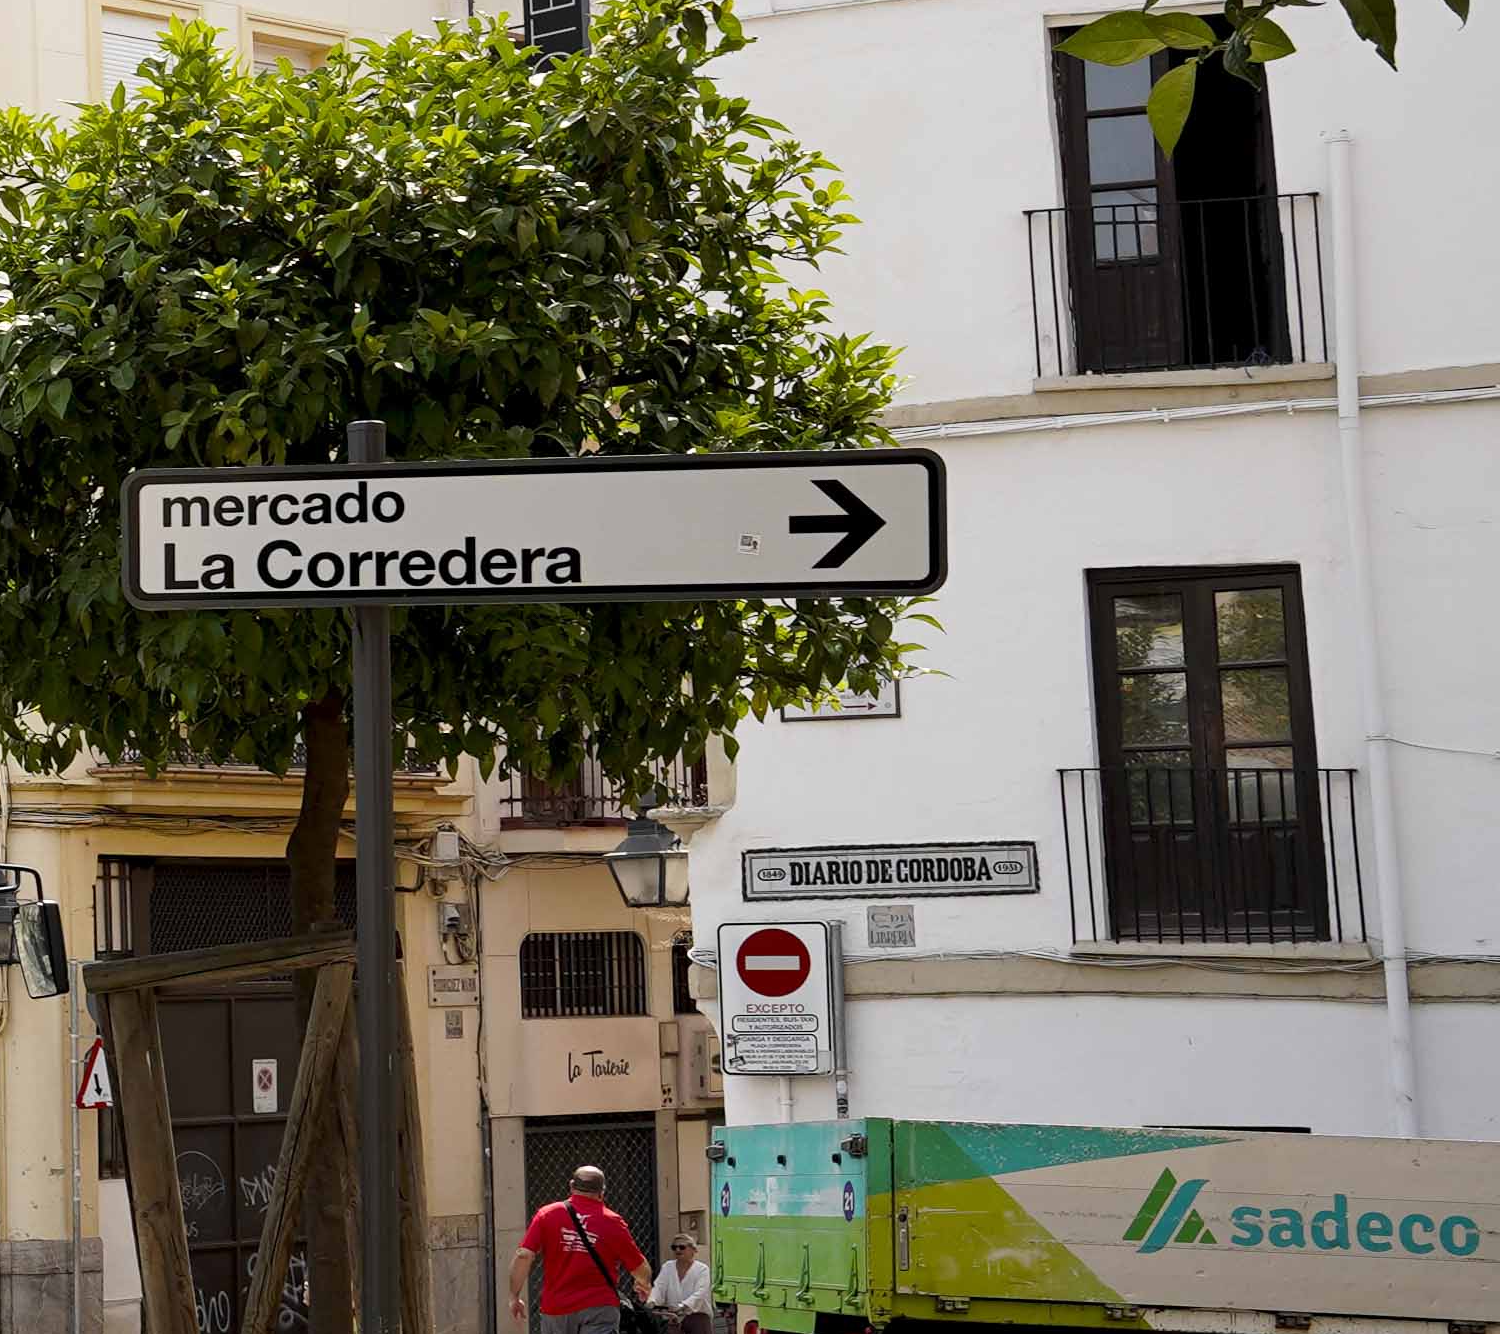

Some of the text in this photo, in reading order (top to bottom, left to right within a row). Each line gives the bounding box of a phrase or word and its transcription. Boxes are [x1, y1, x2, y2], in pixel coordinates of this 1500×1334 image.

[163, 481, 405, 528] mercado
[163, 536, 582, 590] La Corredera
[789, 860, 862, 886] DIARIO
[866, 859, 893, 885] DE
[896, 856, 992, 884] CORDOBA
[746, 1003, 805, 1014] EXCEPTO
[568, 1051, 581, 1083] La
[722, 1190, 730, 1207] 21
[844, 1192, 854, 1209] 21
[1231, 1193, 1480, 1256] sadeco
